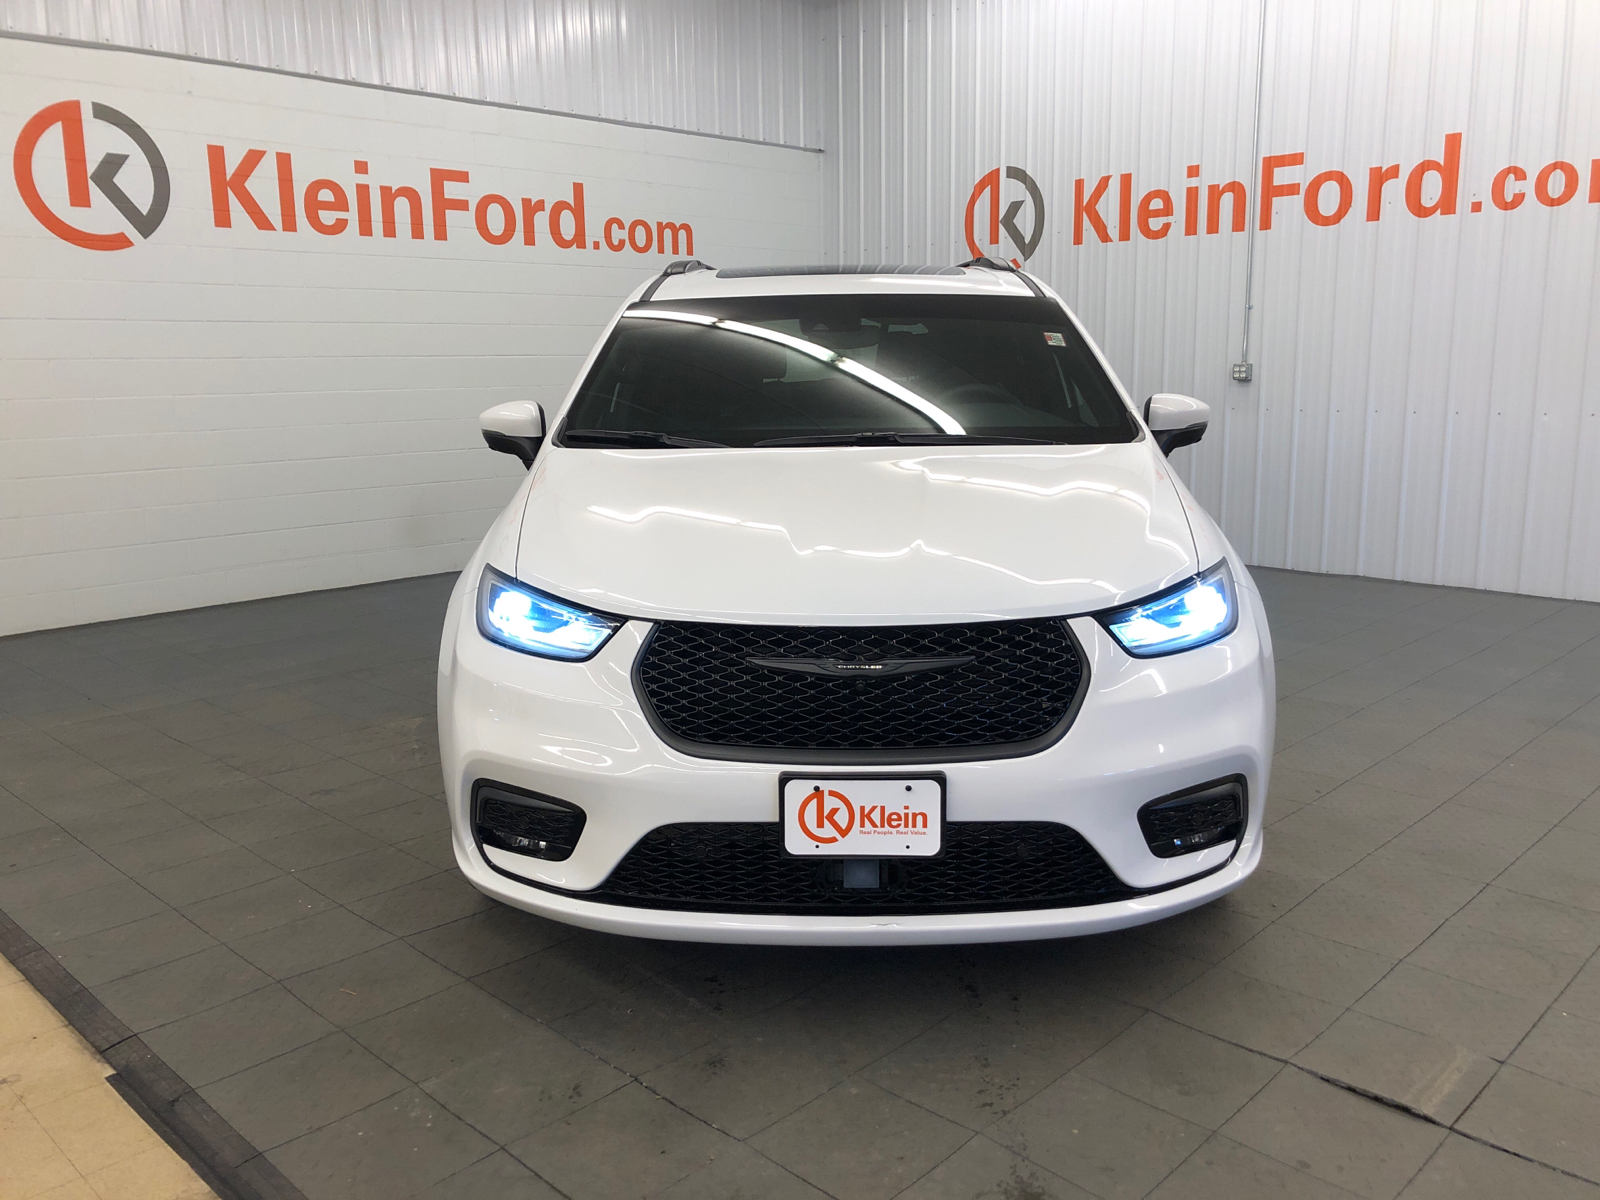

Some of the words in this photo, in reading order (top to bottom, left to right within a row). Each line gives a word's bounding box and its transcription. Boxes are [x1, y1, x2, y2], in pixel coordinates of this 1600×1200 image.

[206, 143, 694, 256] KleinFord.com
[1073, 131, 1600, 246] KleinFord.co
[859, 805, 928, 829] Klein
